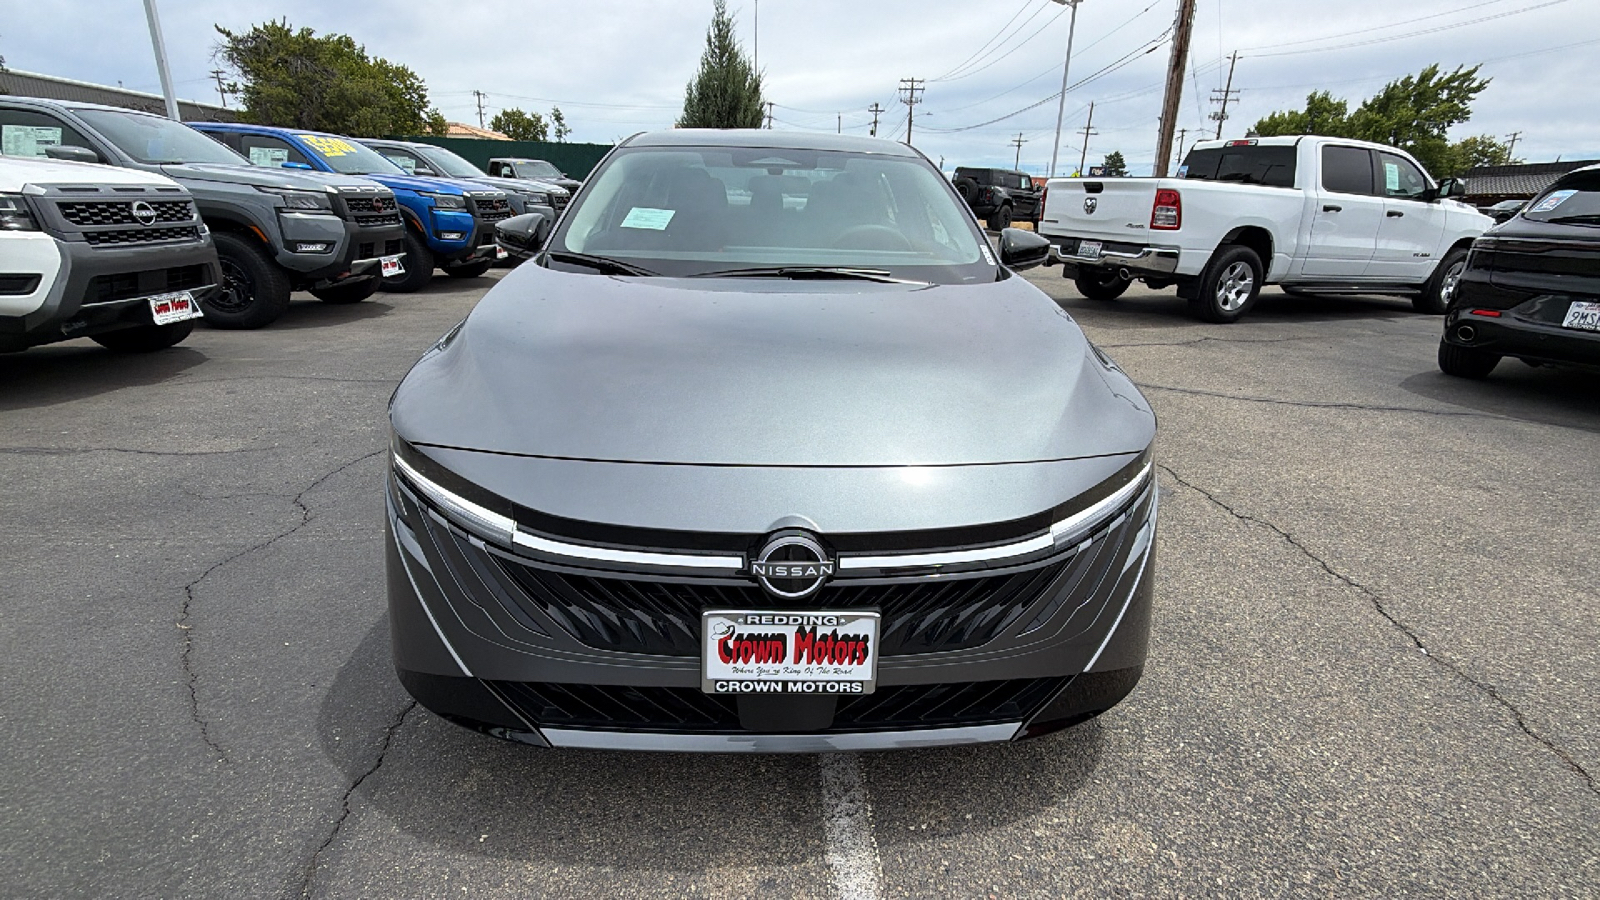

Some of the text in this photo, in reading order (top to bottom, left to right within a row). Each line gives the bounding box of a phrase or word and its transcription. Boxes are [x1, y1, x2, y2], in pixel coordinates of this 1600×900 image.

[752, 564, 833, 577] NISSAN
[746, 615, 838, 626] REDDING
[717, 625, 870, 666] Crown Motors
[731, 666, 854, 677] Where You're King Of The Road
[715, 681, 863, 693] CROWN MOTORS
